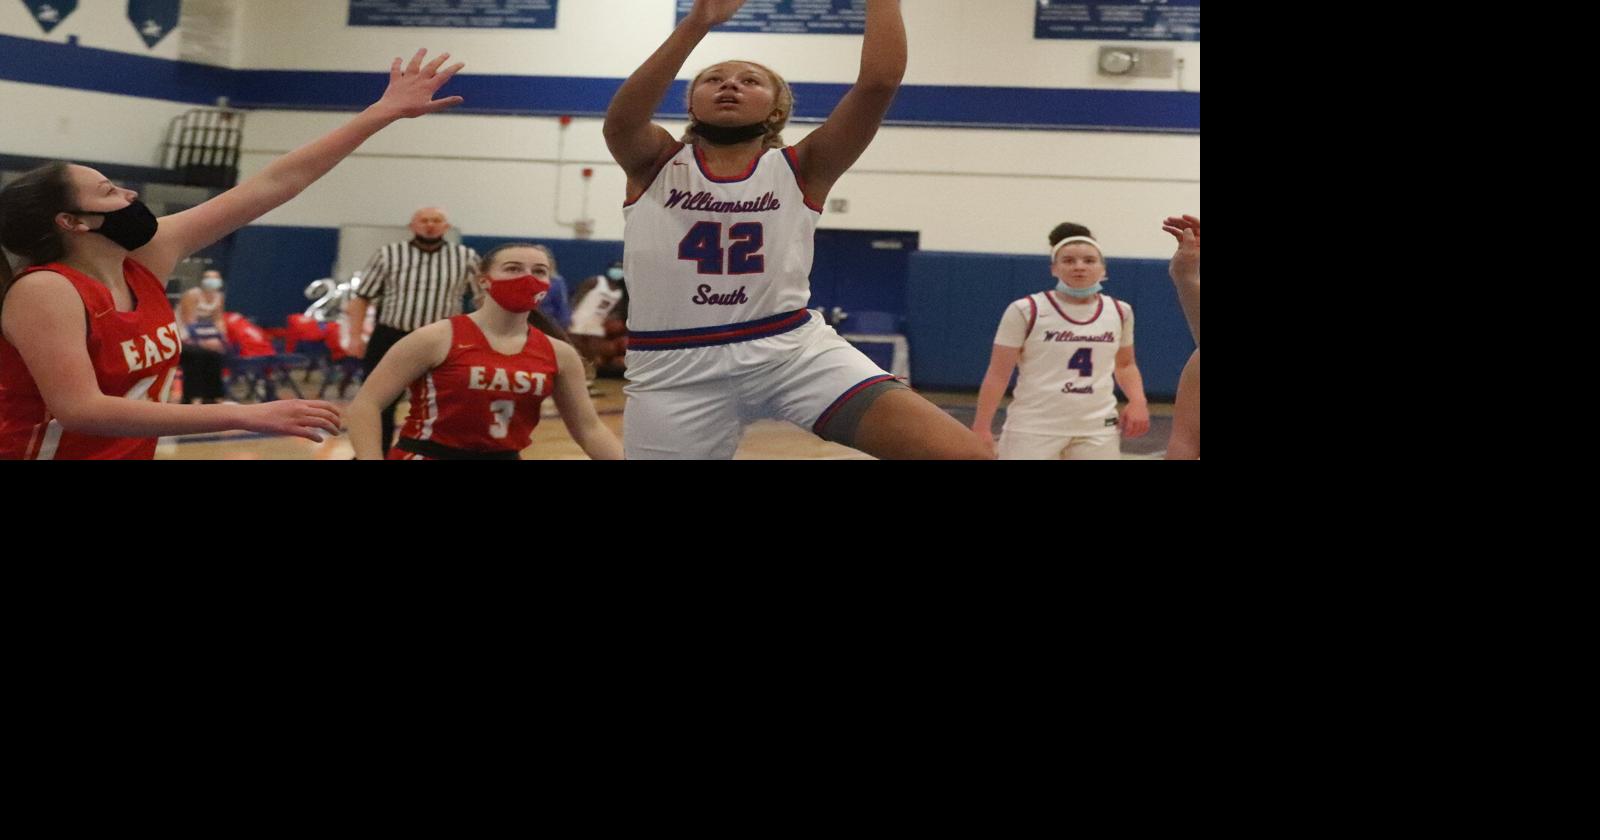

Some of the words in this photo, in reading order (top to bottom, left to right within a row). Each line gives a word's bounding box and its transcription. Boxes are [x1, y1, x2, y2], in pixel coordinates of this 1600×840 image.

[664, 189, 781, 213] Williamsville
[678, 221, 765, 275] 42
[692, 284, 749, 305] South
[1043, 330, 1114, 343] Williamsville
[1067, 347, 1093, 377] 4
[468, 366, 547, 396] EAST
[1060, 382, 1094, 394] South
[489, 401, 514, 439] 3
